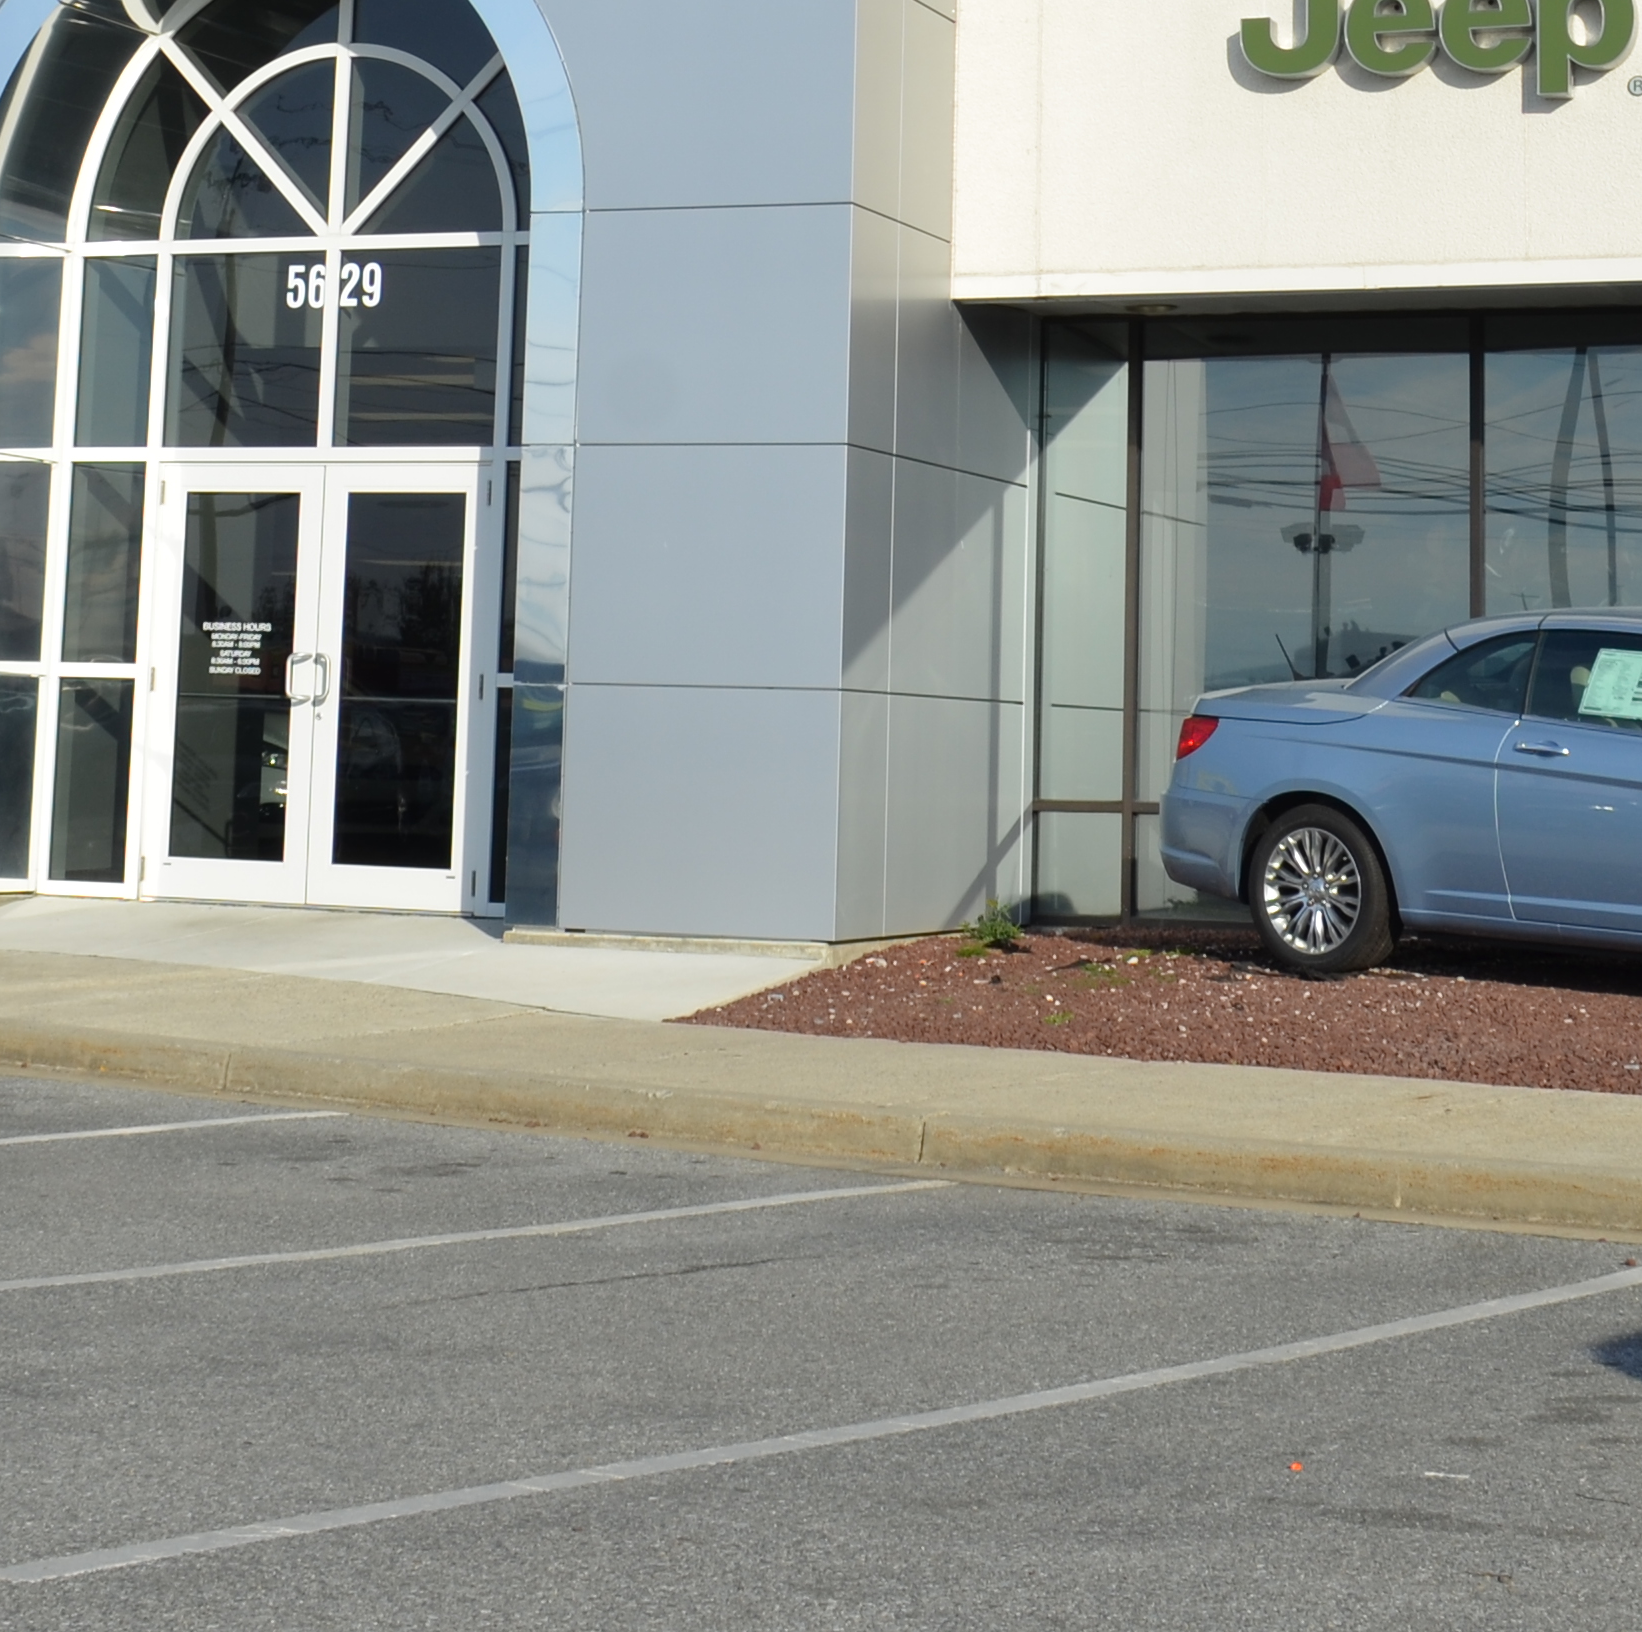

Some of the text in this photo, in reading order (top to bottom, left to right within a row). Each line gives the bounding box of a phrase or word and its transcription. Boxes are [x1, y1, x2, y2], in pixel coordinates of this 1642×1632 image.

[286, 262, 382, 309] 5629
[202, 621, 272, 632] BUSINESS HOURS
[234, 667, 262, 675] CLOSED
